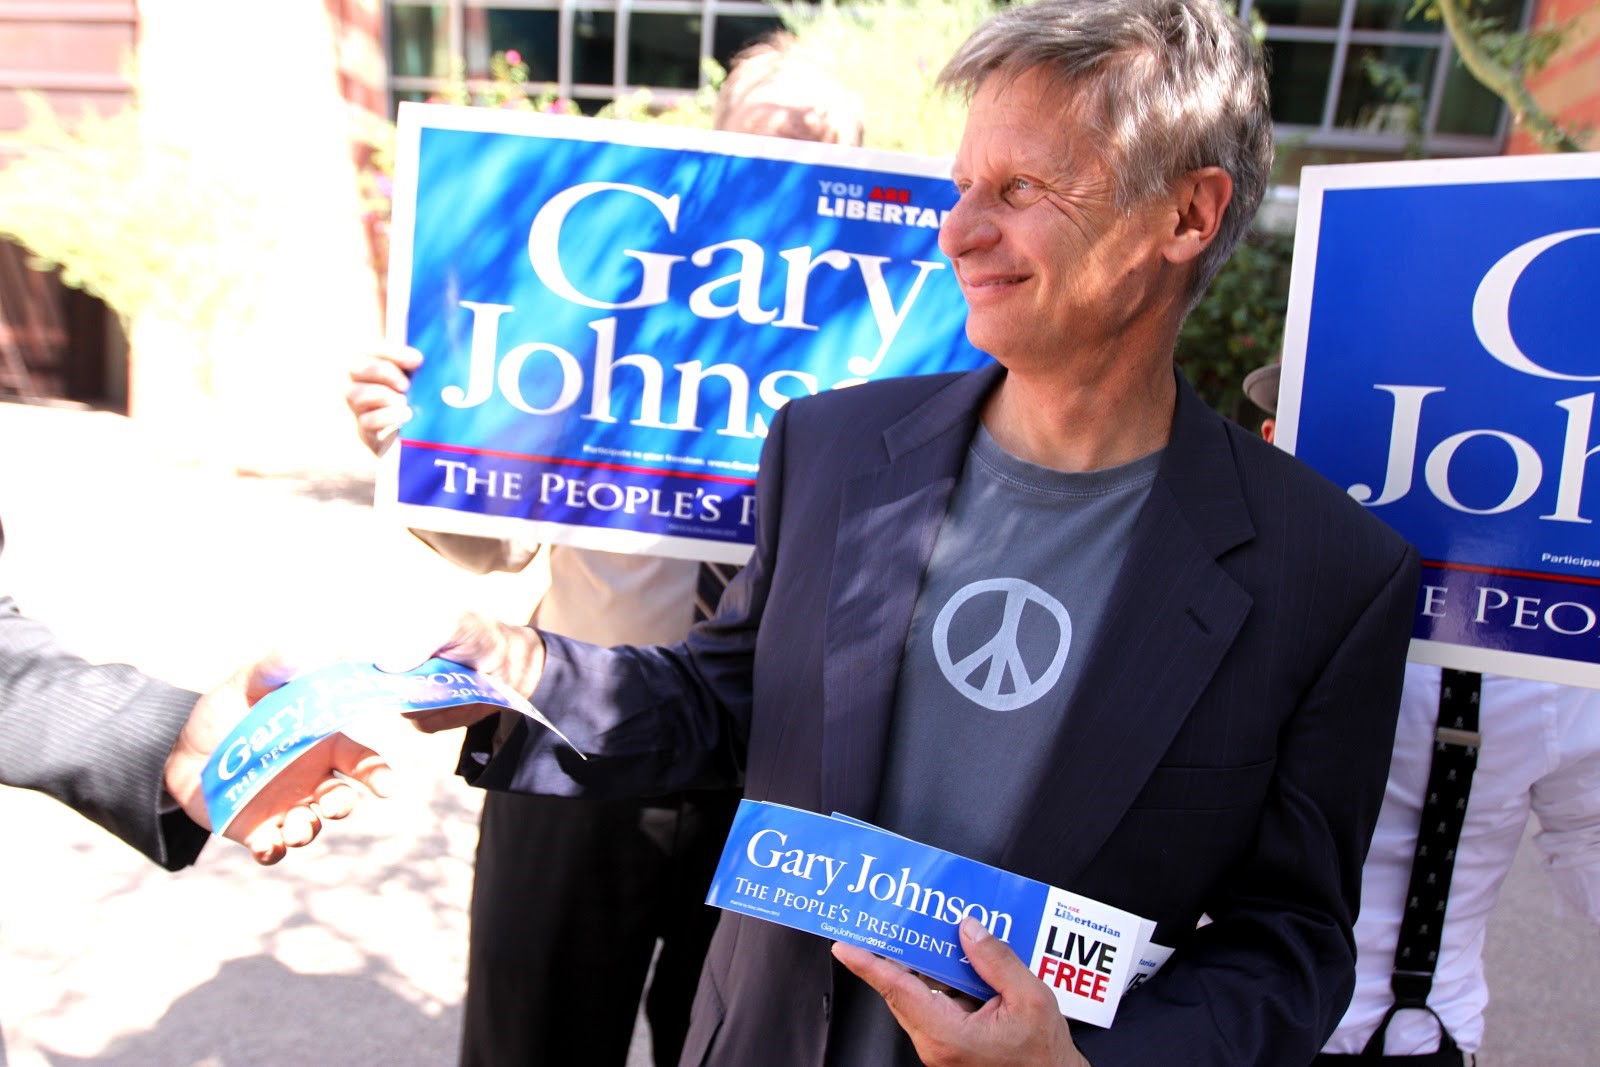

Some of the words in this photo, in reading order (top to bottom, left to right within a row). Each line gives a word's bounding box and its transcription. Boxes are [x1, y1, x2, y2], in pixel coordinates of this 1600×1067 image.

[818, 180, 863, 198] YOU
[869, 186, 911, 204] ARE
[527, 180, 946, 377] Gary
[441, 300, 868, 439] Johns
[434, 458, 523, 500] THE
[540, 472, 723, 523] PEOPLE'S
[1473, 586, 1600, 636] PEO
[449, 687, 491, 699] 2012
[217, 697, 306, 781] Gary
[224, 767, 257, 802] THE
[746, 828, 848, 895] Gary
[847, 853, 1013, 944] Johnson
[735, 877, 770, 900] THE
[773, 887, 850, 924] PEOPLE'S
[855, 911, 957, 958] PRESIDENT
[820, 922, 904, 955] GaryJohnson2012.com
[1054, 908, 1121, 938] Libertarian
[1044, 925, 1117, 975] LIVE
[1037, 955, 1111, 1003] FREE
